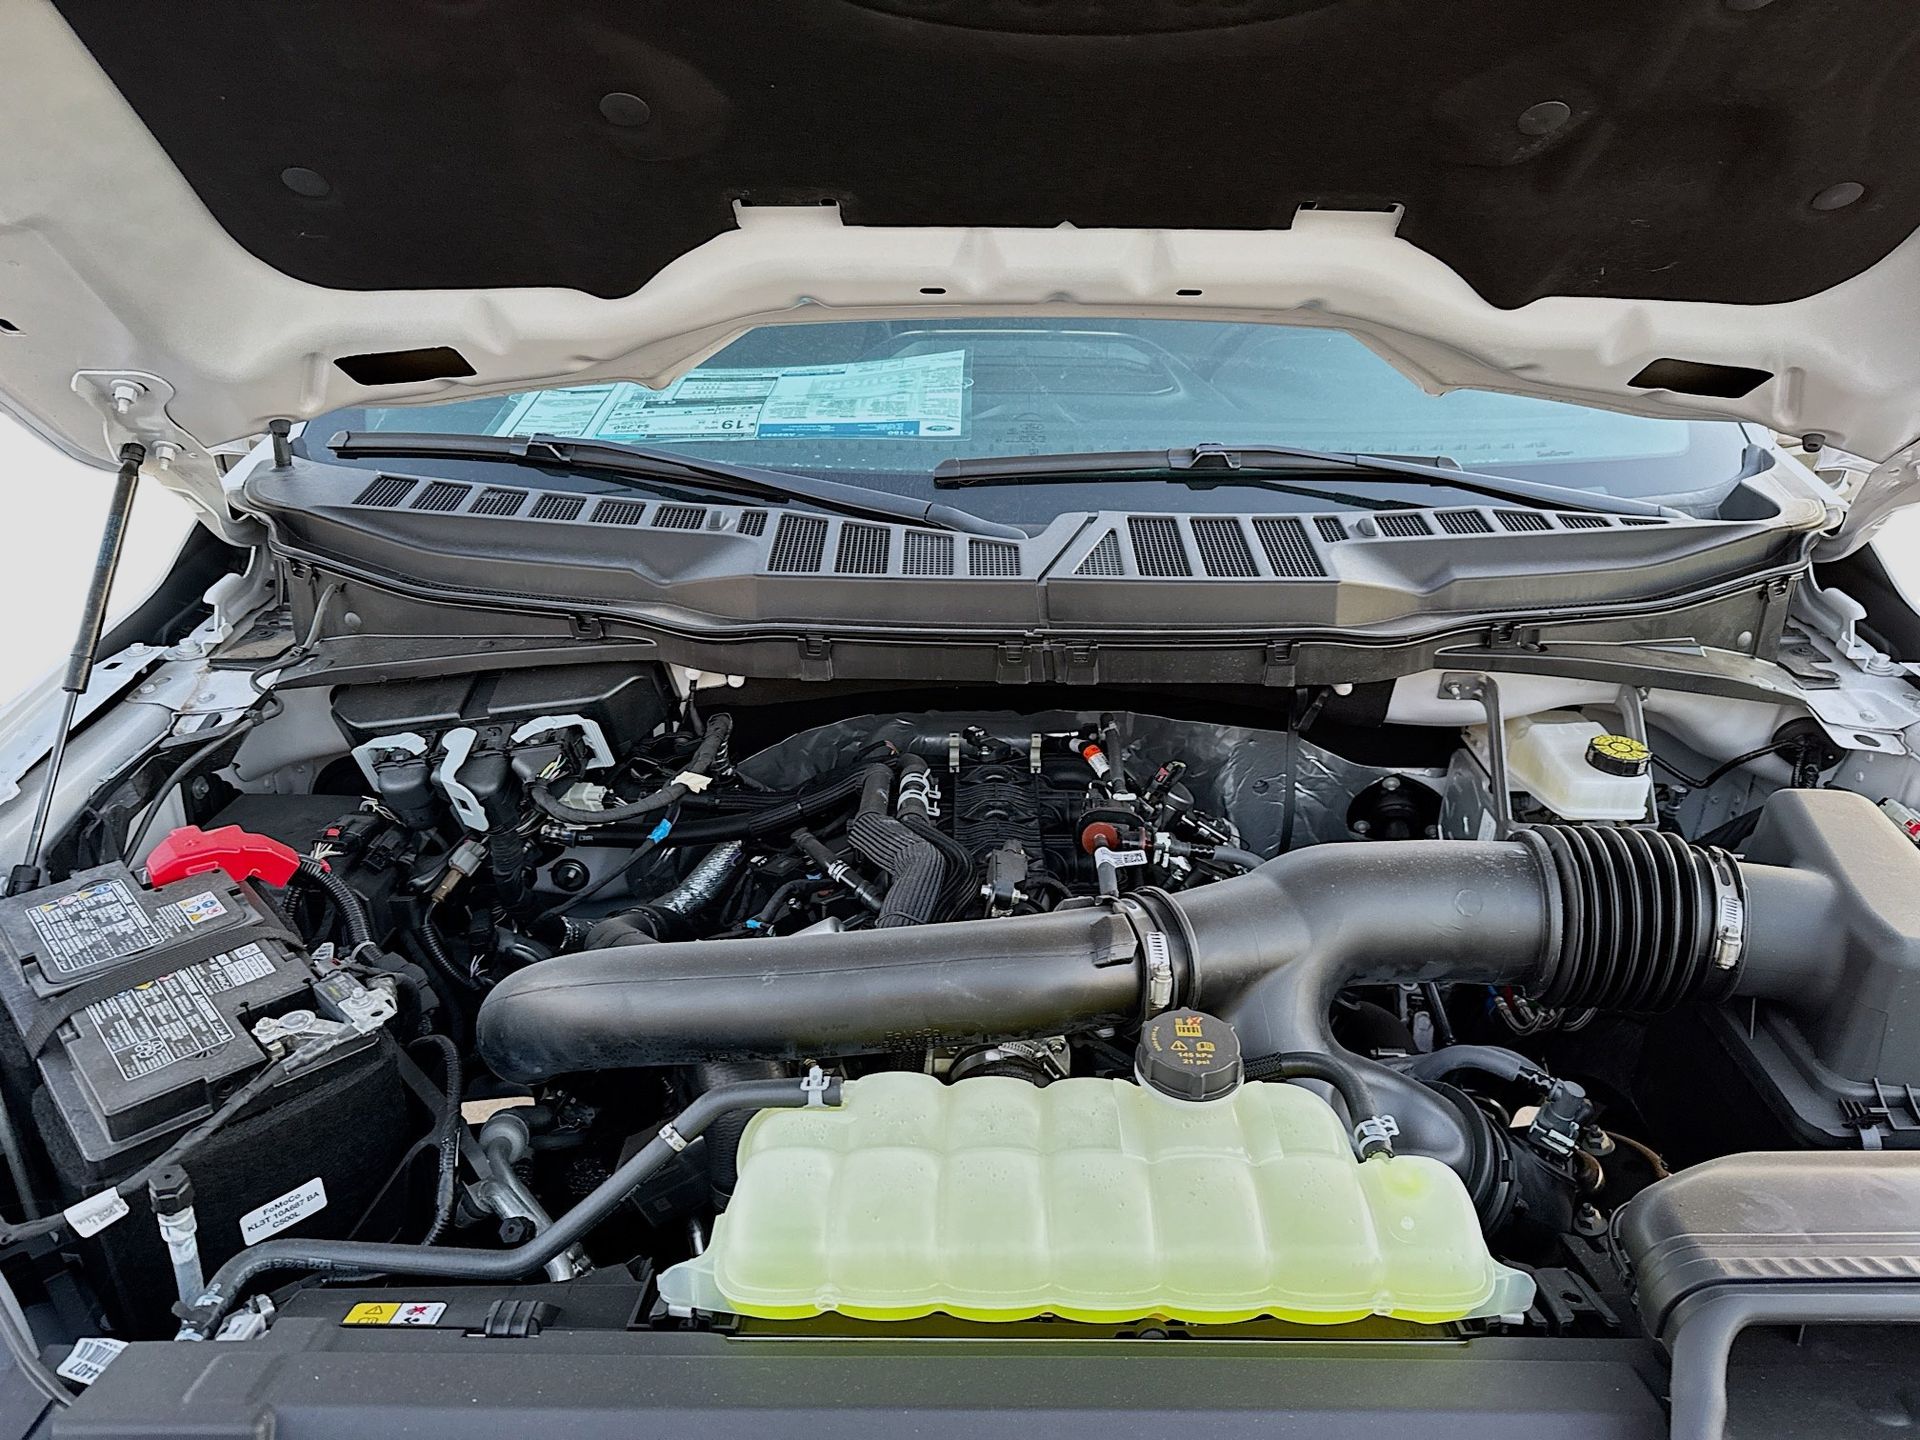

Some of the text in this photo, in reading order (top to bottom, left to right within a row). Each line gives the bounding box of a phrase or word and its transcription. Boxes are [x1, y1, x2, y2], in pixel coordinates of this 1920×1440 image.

[721, 420, 745, 430] 19
[247, 1216, 271, 1232] KL3T
[306, 1191, 320, 1202] BA
[263, 1193, 301, 1216] FoMoCo
[68, 1362, 99, 1380] 4407
